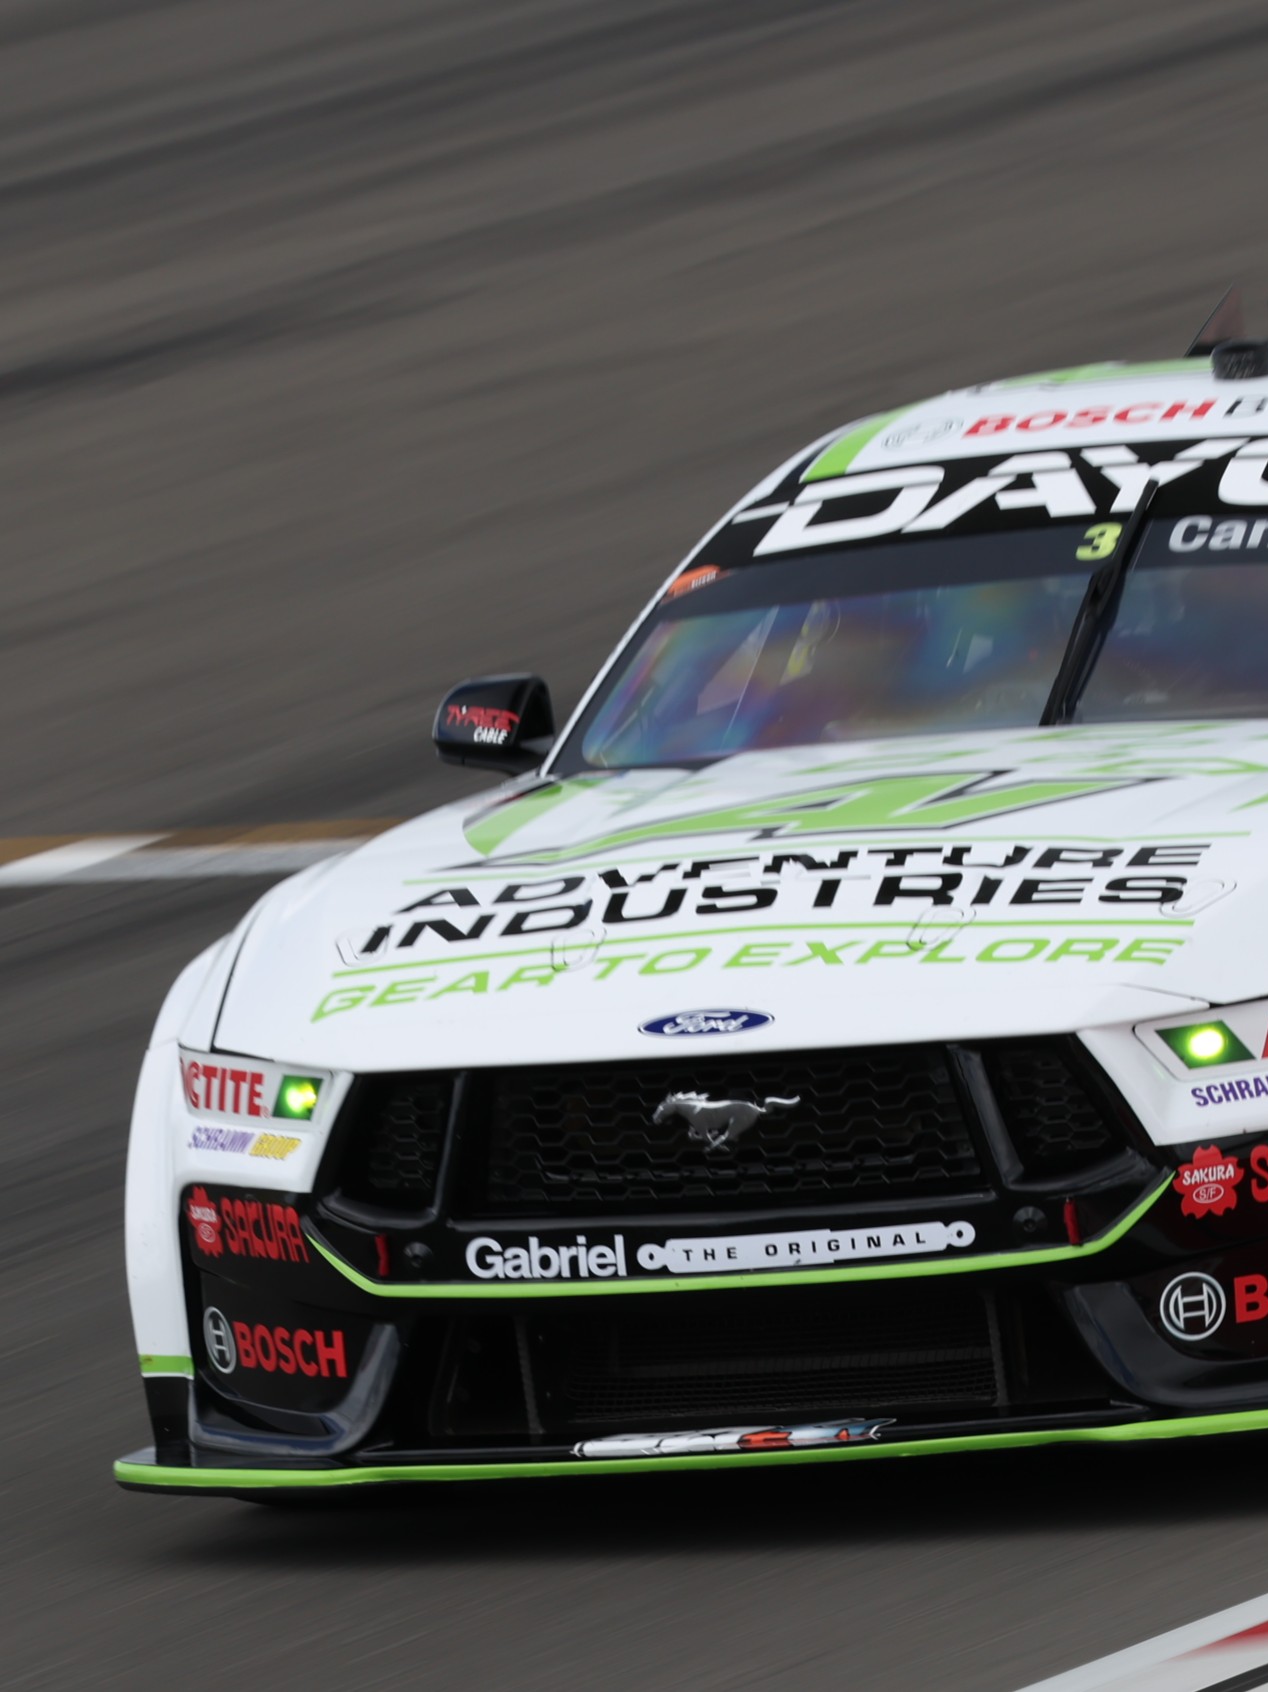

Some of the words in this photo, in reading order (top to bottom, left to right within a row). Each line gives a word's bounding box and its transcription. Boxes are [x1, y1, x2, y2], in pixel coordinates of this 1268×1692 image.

[962, 398, 1218, 439] BOSCH
[1075, 522, 1123, 561] 3
[473, 726, 508, 745] CABLE
[394, 842, 1212, 915] ADVENTURE
[361, 873, 1190, 953] INDUSTRIES
[310, 969, 556, 1023] GEAR
[596, 946, 712, 982] TO
[722, 937, 1186, 969] EXPLORE
[663, 1011, 749, 1035] Ford
[179, 1056, 264, 1117] CTITE
[1182, 1163, 1235, 1186] SAKURA
[221, 1197, 311, 1264] SAKURA
[683, 1246, 738, 1262] THE
[765, 1231, 927, 1257] ORIGINAL
[465, 1235, 627, 1280] Gabriel
[232, 1320, 347, 1378] BOSCH
